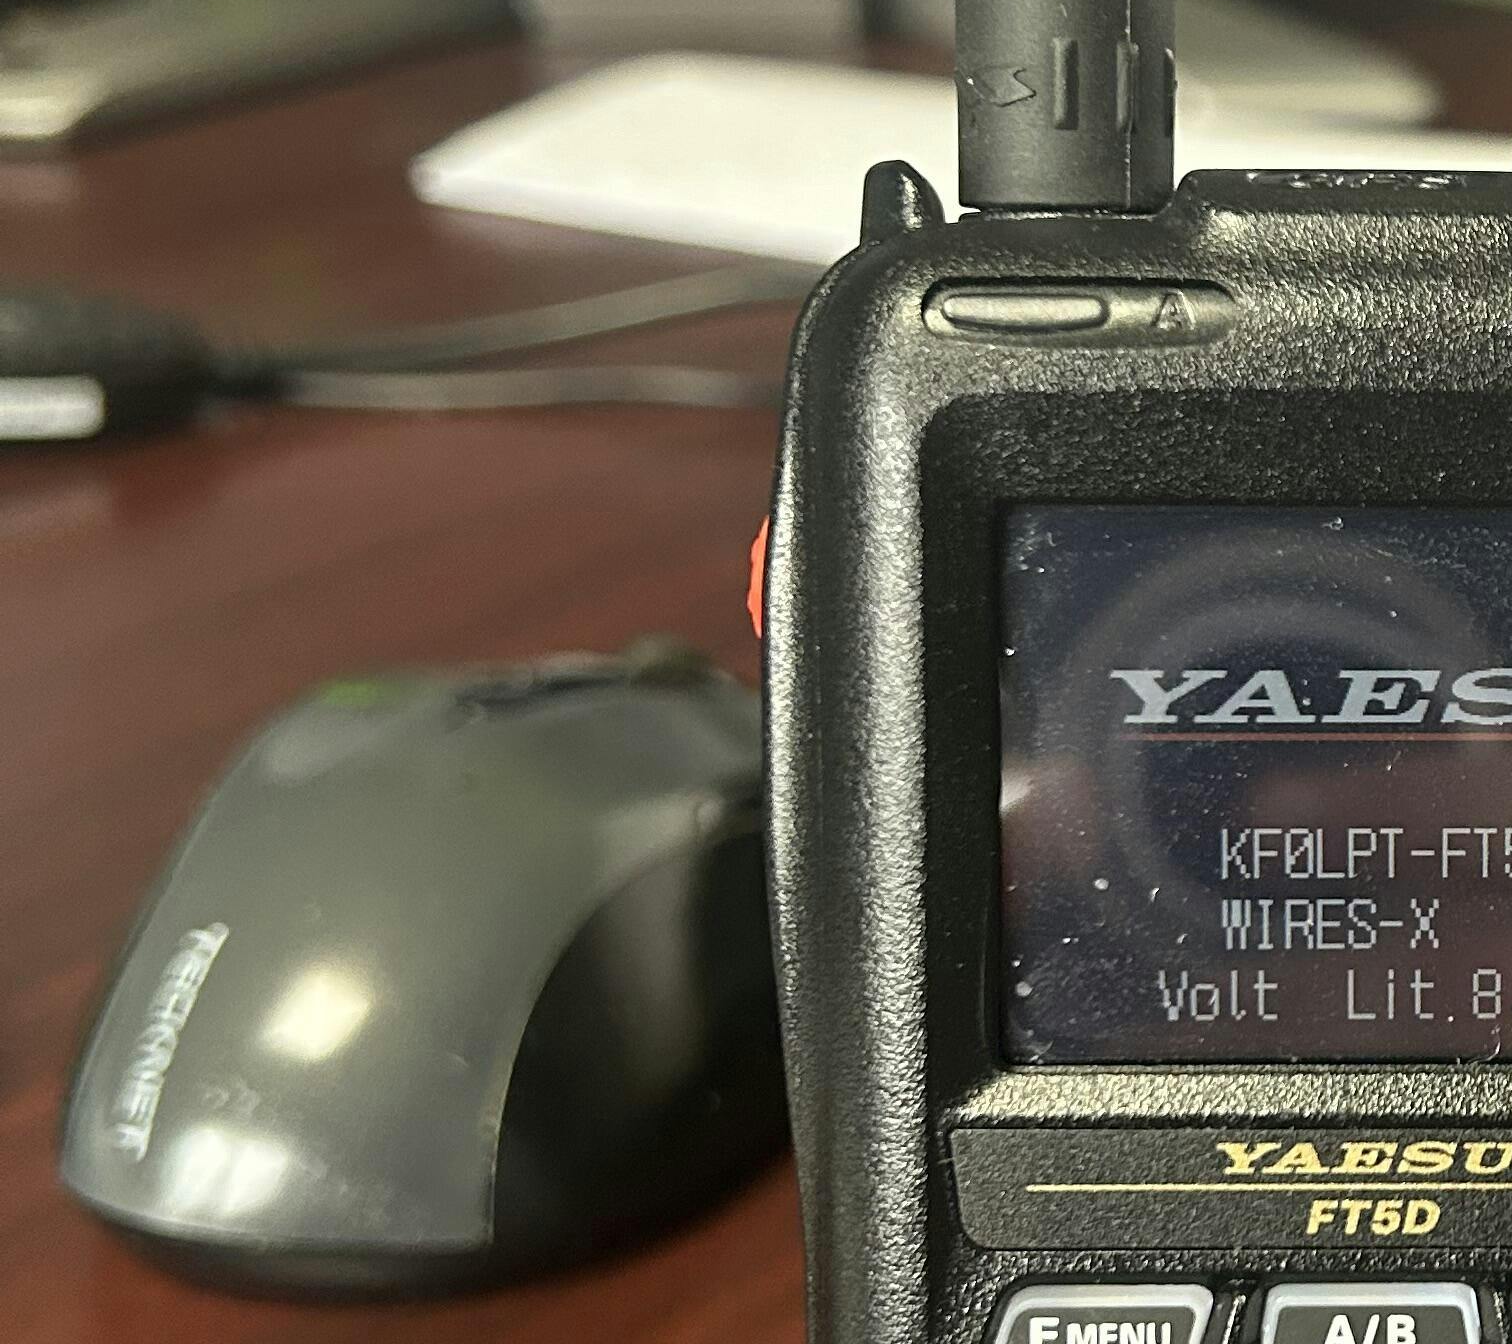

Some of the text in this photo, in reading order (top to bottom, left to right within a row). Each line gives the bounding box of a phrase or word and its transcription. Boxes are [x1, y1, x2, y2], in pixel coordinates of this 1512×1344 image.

[1221, 898, 1441, 950] WIRES-X
[1157, 969, 1279, 1021] Volt
[1306, 1200, 1442, 1236] FT5D
